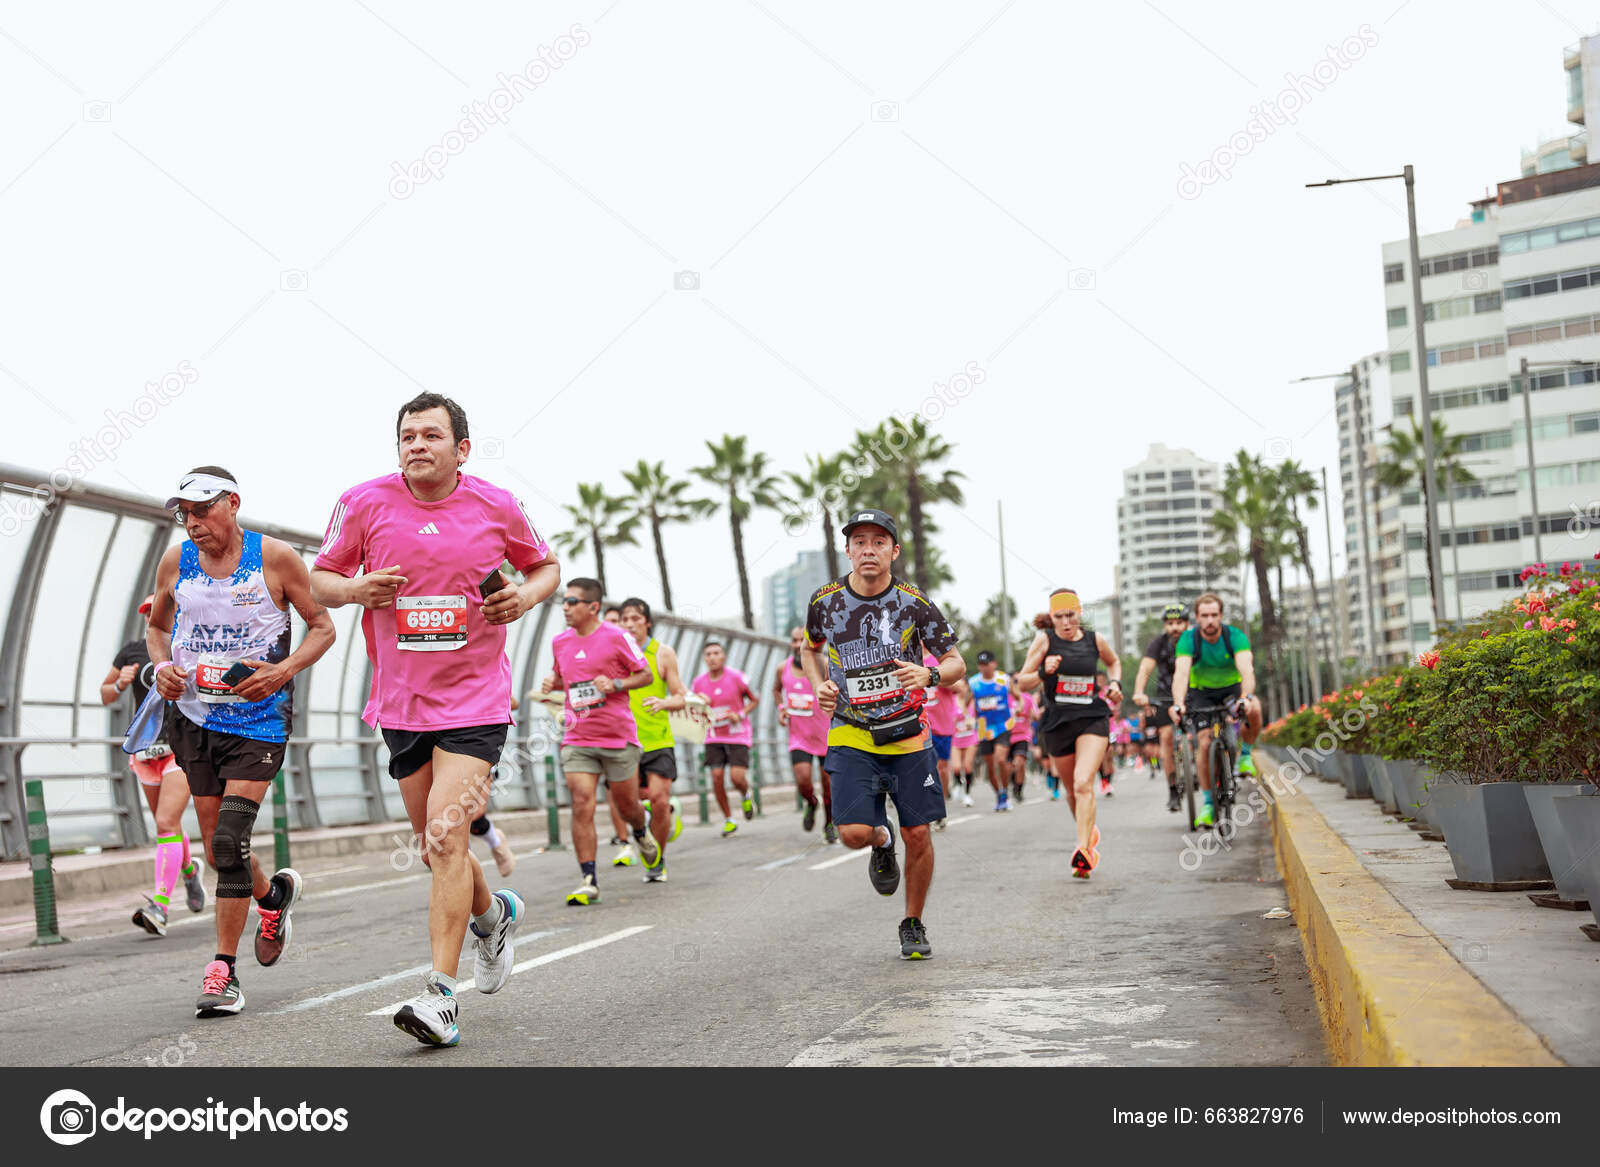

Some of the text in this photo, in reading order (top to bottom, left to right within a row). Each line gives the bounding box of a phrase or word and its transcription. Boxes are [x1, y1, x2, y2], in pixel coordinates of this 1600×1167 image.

[407, 610, 455, 627] 6990
[191, 623, 249, 640] AYNI
[181, 638, 266, 653] RUNNERS
[838, 637, 864, 656] TEAM
[842, 643, 900, 671] ANGELICALES
[857, 675, 889, 692] 2331
